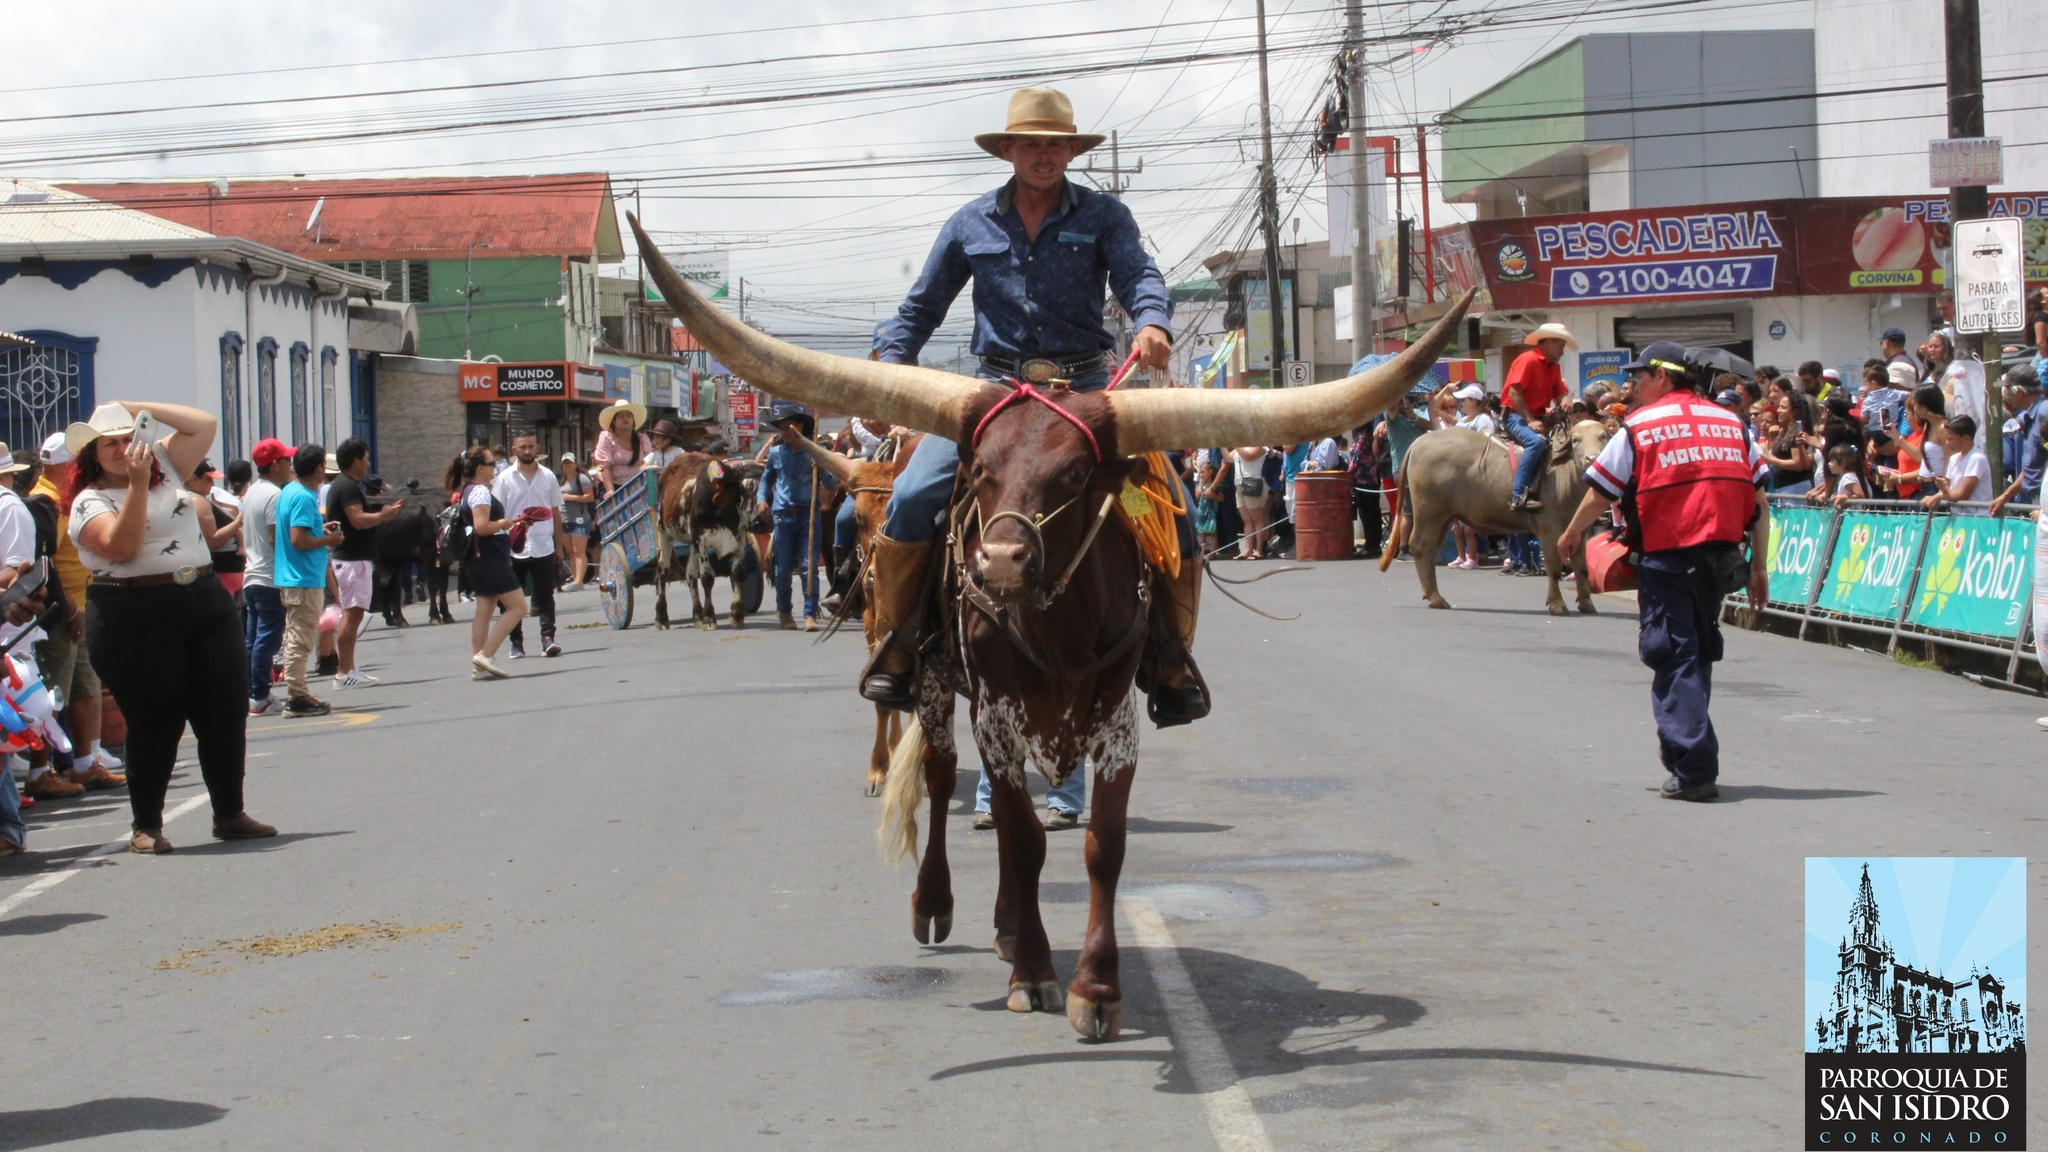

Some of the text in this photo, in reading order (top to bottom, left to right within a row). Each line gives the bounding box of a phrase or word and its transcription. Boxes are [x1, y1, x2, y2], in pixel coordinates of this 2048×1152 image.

[1535, 211, 1782, 261] PESCADERIA
[1598, 263, 1752, 294] 2100-4047
[1857, 273, 1915, 284] CORVINA
[1968, 281, 2009, 296] PARADA
[1982, 297, 1996, 311] DE
[1962, 311, 2019, 328] AUTOBUSES
[508, 369, 554, 379] MUNDO
[1295, 368, 1302, 380] E
[464, 376, 492, 389] MC
[500, 379, 563, 391] COSMÉTICO
[1637, 423, 1693, 446] CRUZ
[1860, 525, 1915, 587] kölbi
[1958, 529, 2028, 600] kölbi
